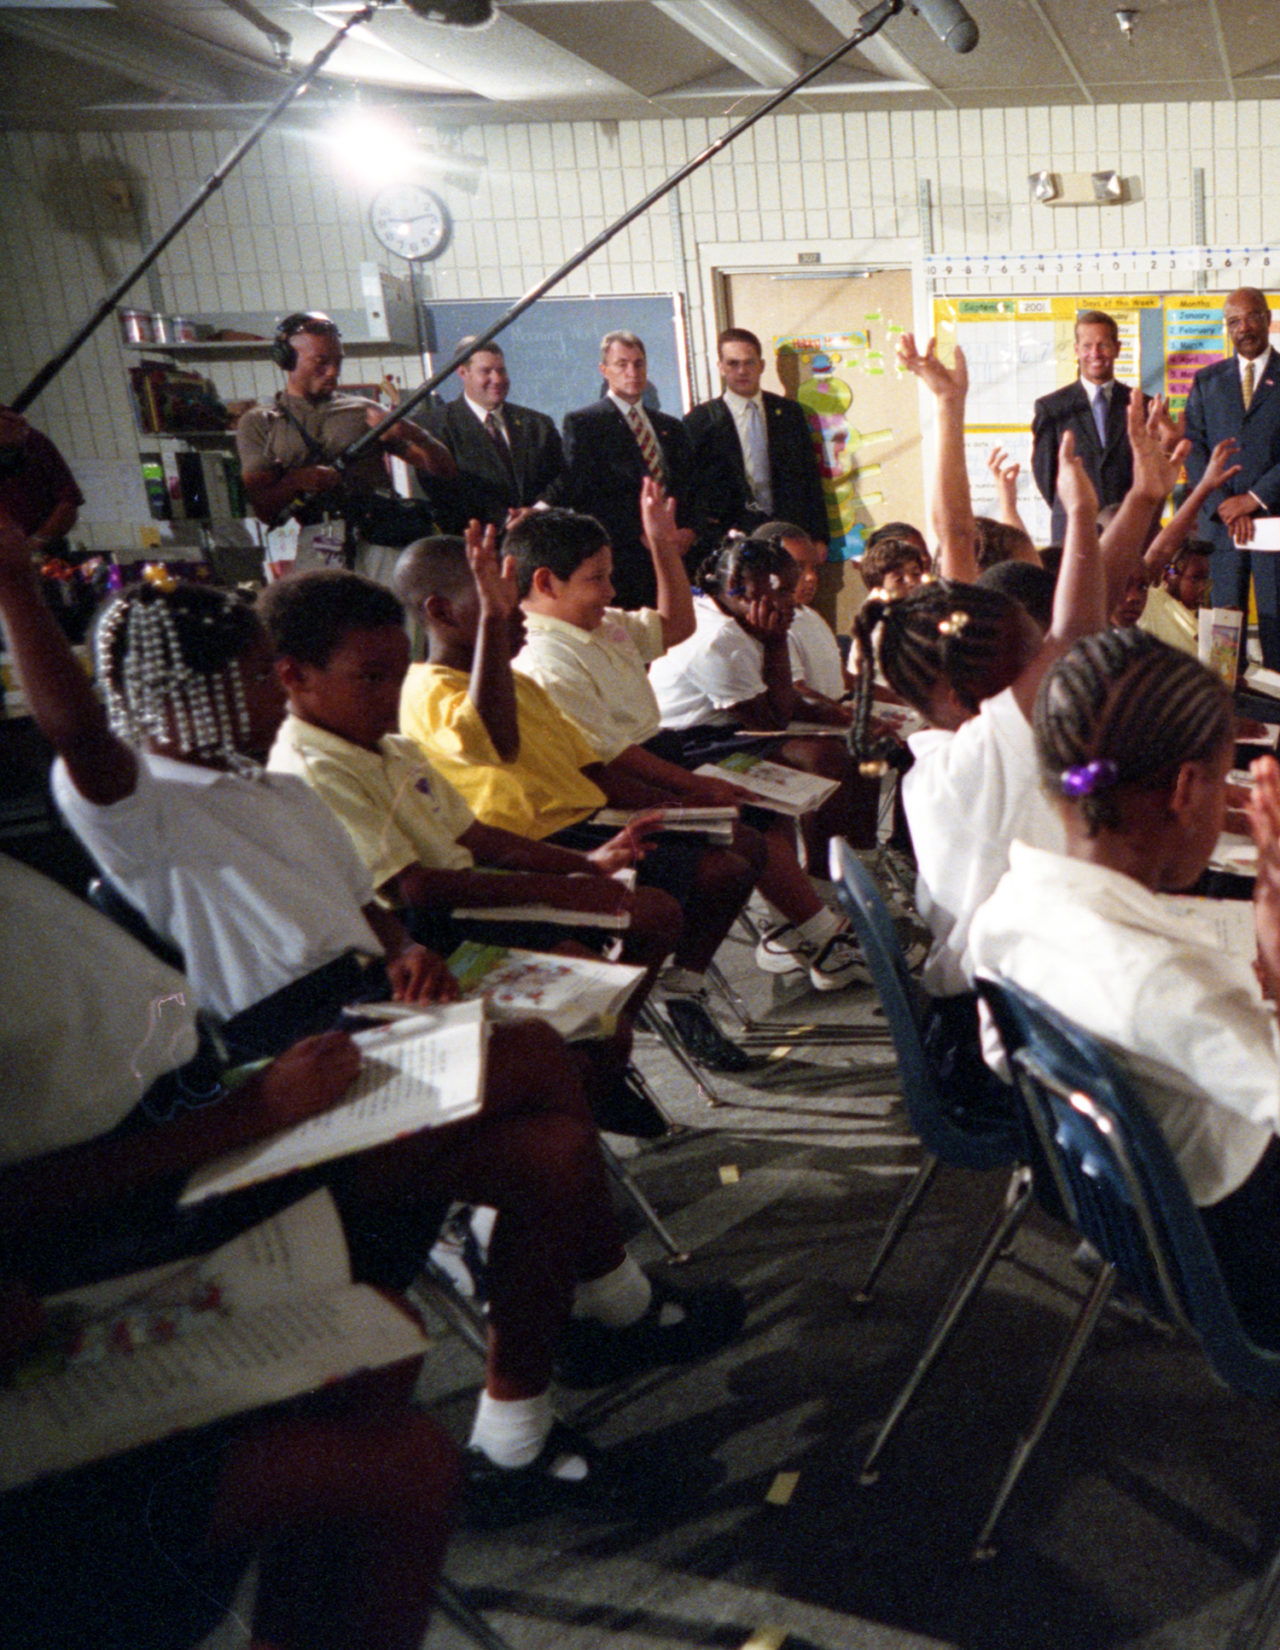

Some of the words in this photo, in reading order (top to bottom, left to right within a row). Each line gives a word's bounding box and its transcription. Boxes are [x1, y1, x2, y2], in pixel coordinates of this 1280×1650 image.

[1112, 261, 1120, 271] 0
[1150, 260, 1158, 270] 2
[1170, 259, 1176, 269] 3
[1206, 257, 1213, 268] 5
[1224, 257, 1232, 267] 6
[1243, 257, 1251, 267] 7
[1263, 256, 1271, 266] 8
[1179, 300, 1211, 308] Months
[1179, 312, 1211, 322] January
[1179, 326, 1216, 335] February
[1179, 341, 1204, 351] March
